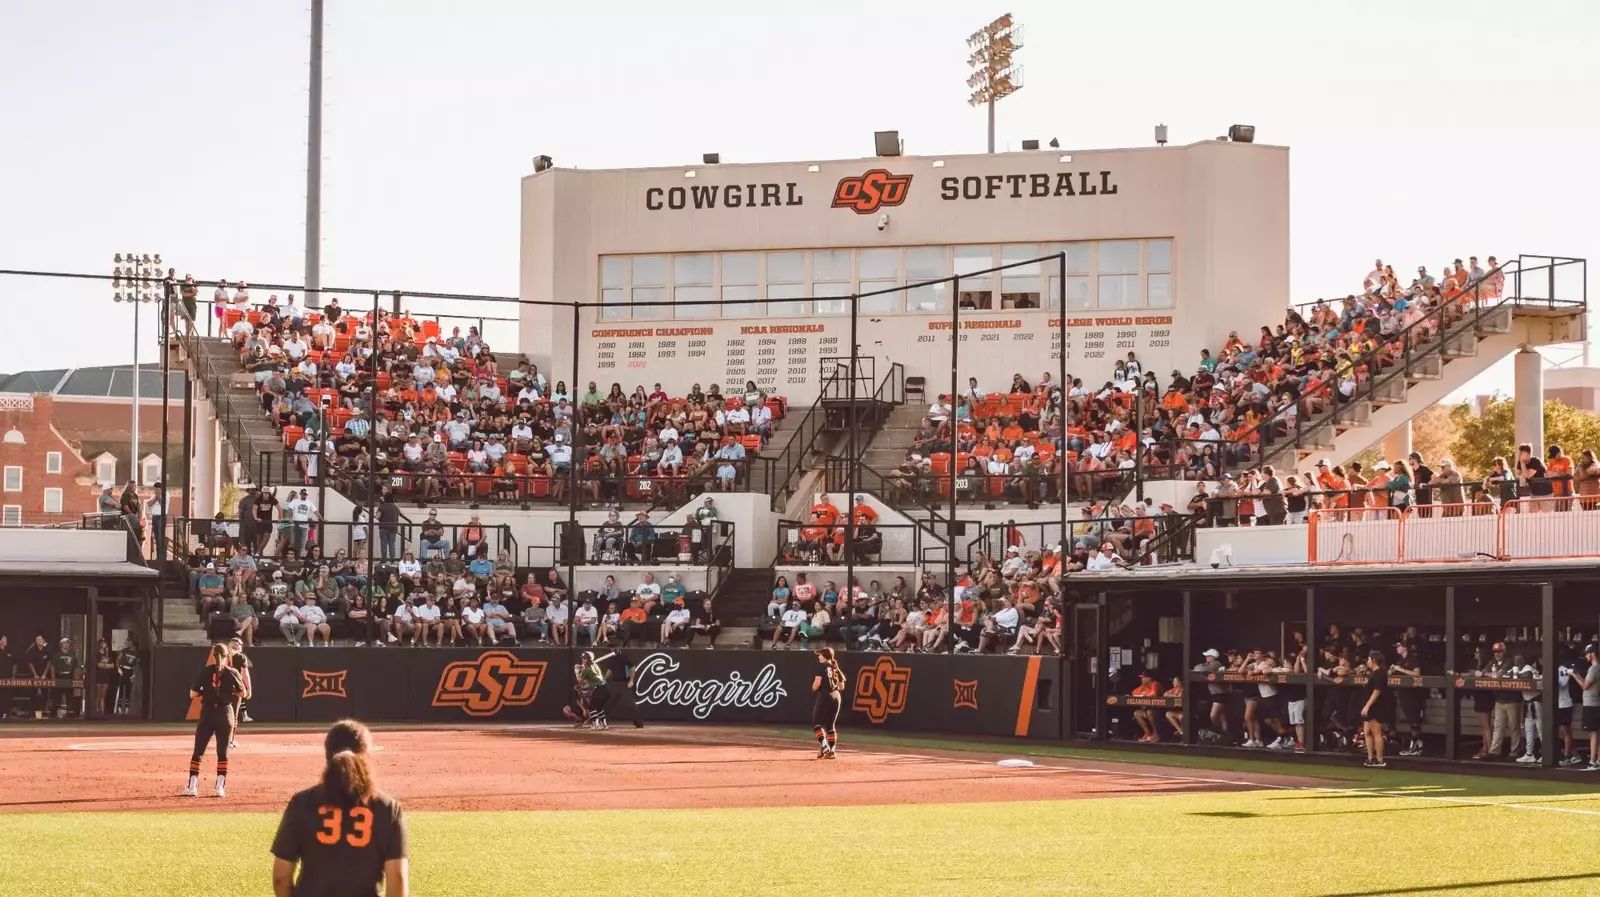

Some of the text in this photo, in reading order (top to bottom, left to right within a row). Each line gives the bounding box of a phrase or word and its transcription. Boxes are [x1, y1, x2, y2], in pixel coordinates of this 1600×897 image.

[646, 169, 1117, 214] COWGIRL OSU SOFTBALL
[964, 320, 1021, 329] REGIONALS
[1048, 316, 1172, 327] COLEGE WORLD SERIES
[592, 327, 713, 338] CONFERENCE CHAMPIONS
[741, 324, 824, 334] NCAA REGIONALS
[391, 477, 403, 487] 201
[639, 480, 651, 490] 202
[956, 479, 968, 489] 203
[434, 651, 546, 716] OSU
[635, 652, 787, 719] Cowgirls
[1475, 680, 1500, 688] COWGIRL
[1501, 681, 1531, 689] SOFTBALL
[853, 656, 911, 723] OSU
[316, 805, 374, 848] 33
